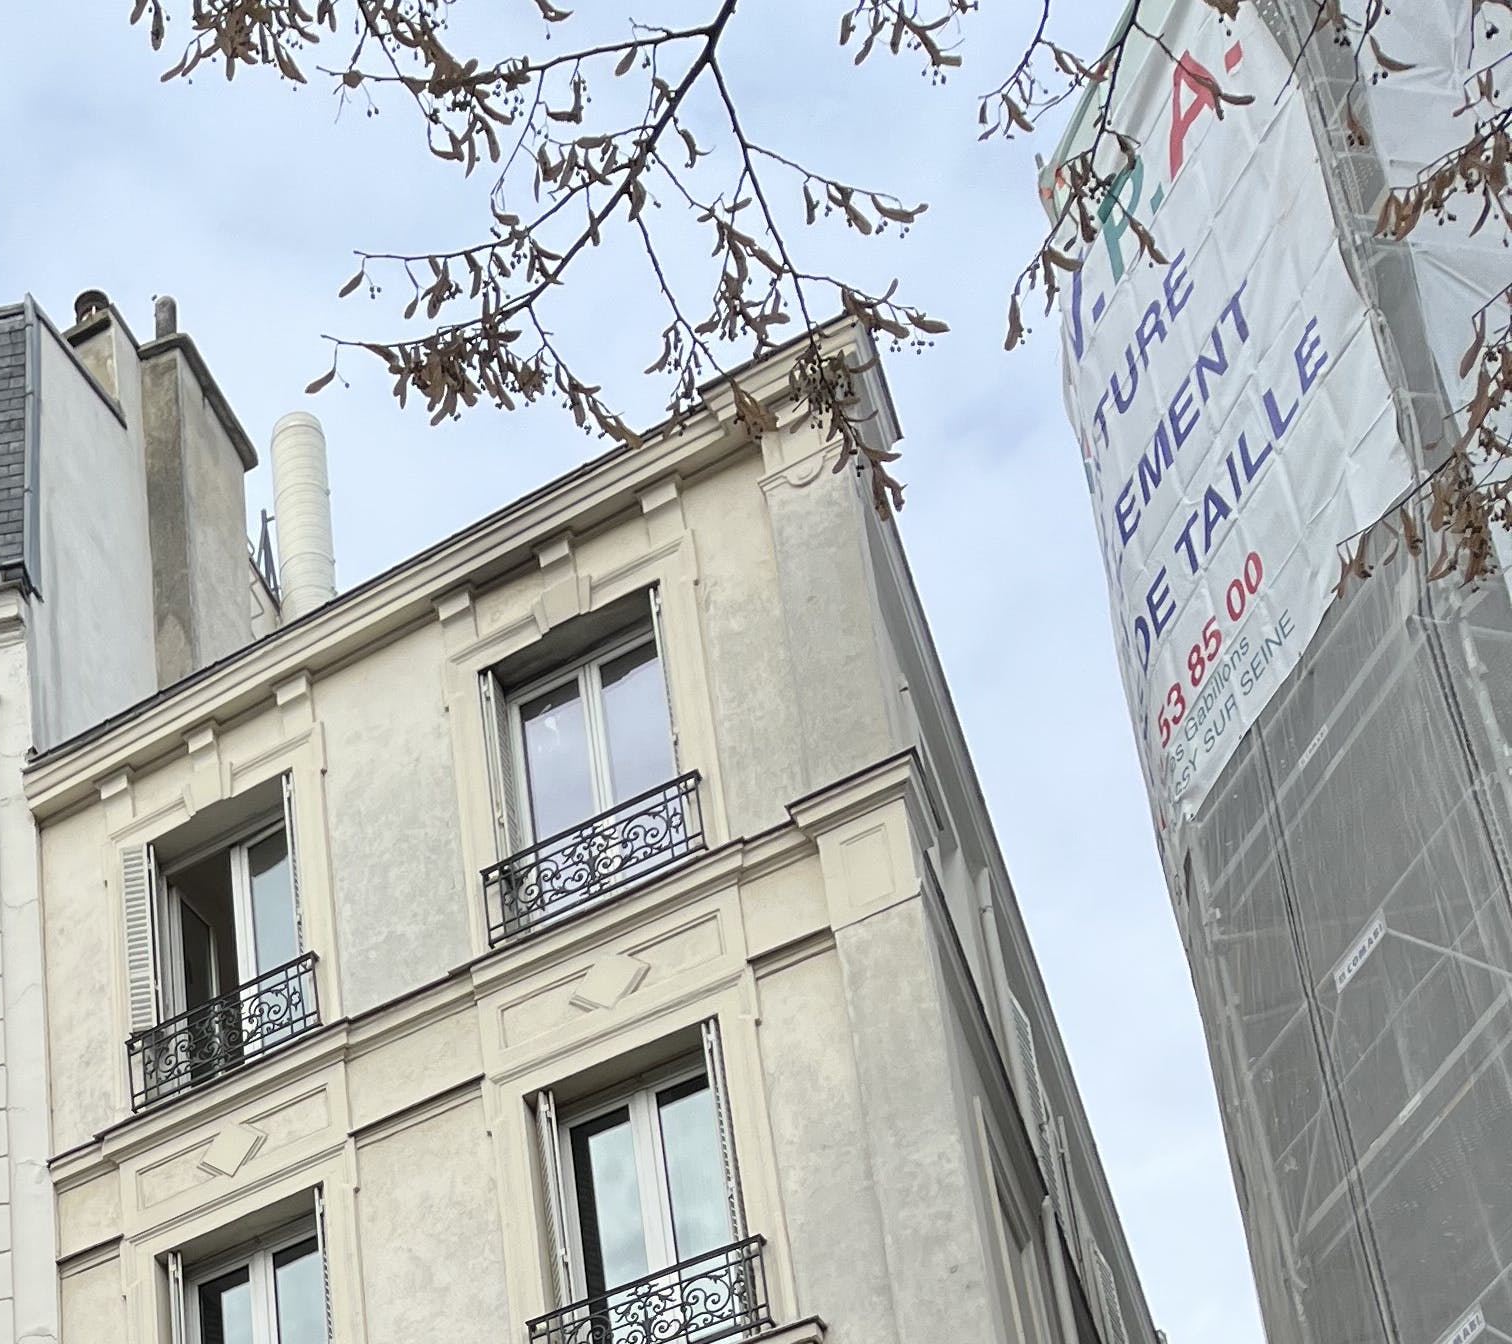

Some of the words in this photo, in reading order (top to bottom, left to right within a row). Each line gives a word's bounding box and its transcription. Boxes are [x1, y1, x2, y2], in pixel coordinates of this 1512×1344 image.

[1093, 248, 1194, 449] TURE
[1114, 278, 1249, 548] EMENT
[1174, 315, 1329, 575] TAILLE
[1183, 636, 1250, 742] Gabillons
[1187, 615, 1222, 688] 85
[1226, 551, 1263, 622] 00
[1203, 694, 1239, 753] SUR
[1240, 608, 1296, 696] SEINE
